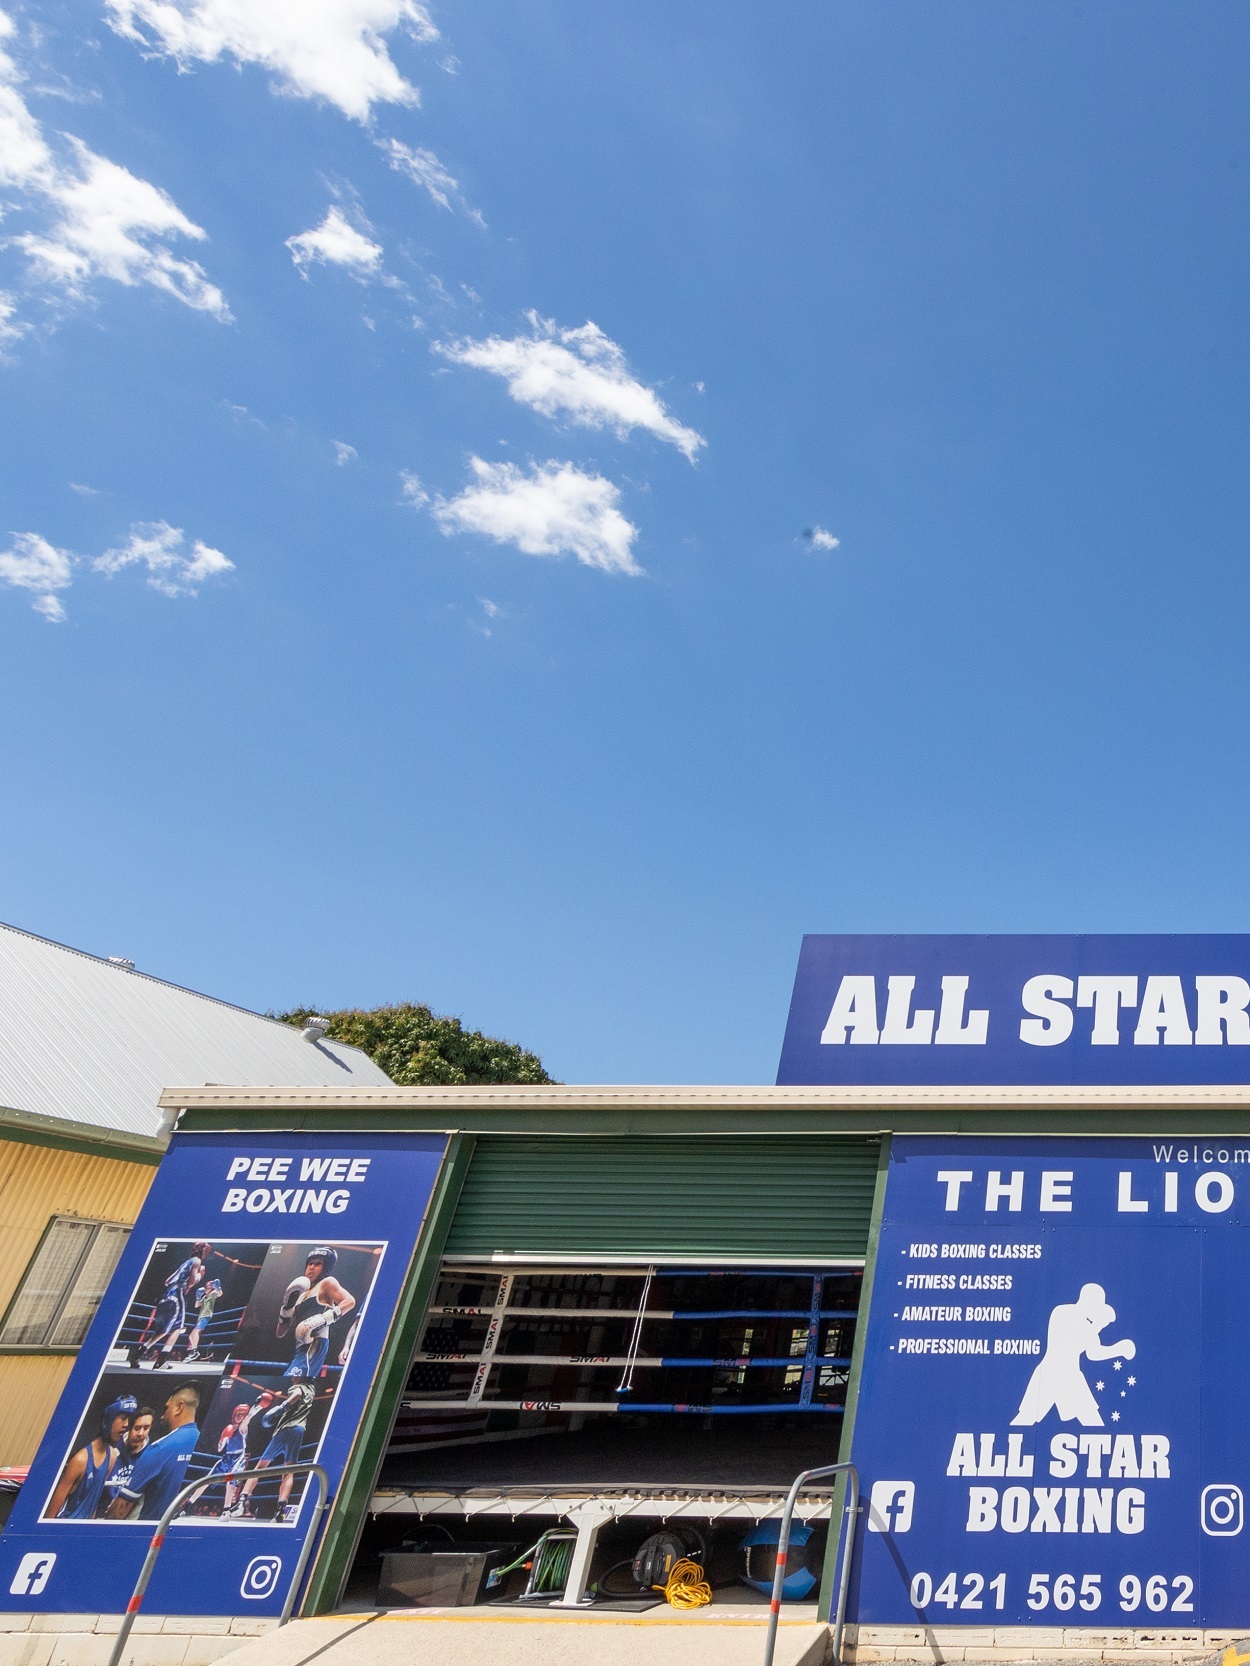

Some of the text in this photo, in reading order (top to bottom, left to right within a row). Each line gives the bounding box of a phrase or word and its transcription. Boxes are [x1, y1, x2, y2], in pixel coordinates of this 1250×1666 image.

[819, 975, 990, 1045] ALL
[225, 1157, 372, 1182] PEE WEE
[221, 1188, 351, 1214] BOXING
[936, 1170, 1074, 1212] THE
[909, 1243, 939, 1258] KIDS
[940, 1243, 986, 1259] BOXING
[988, 1244, 1042, 1259] CLASSES
[496, 1275, 509, 1306] SMAI
[905, 1274, 957, 1290] FITNESS
[959, 1274, 1013, 1290] CLASSES
[901, 1306, 963, 1322] AMATEUR
[965, 1306, 1012, 1322] BOXING
[485, 1318, 498, 1350] SMAI
[897, 1338, 991, 1355] PROFESSIONAL
[993, 1339, 1041, 1355] BOXING
[473, 1362, 487, 1395] SMAI
[946, 1432, 1171, 1479] ALL STAR
[965, 1486, 1146, 1535] BOXING
[910, 1571, 1194, 1612] 0421 565 962
